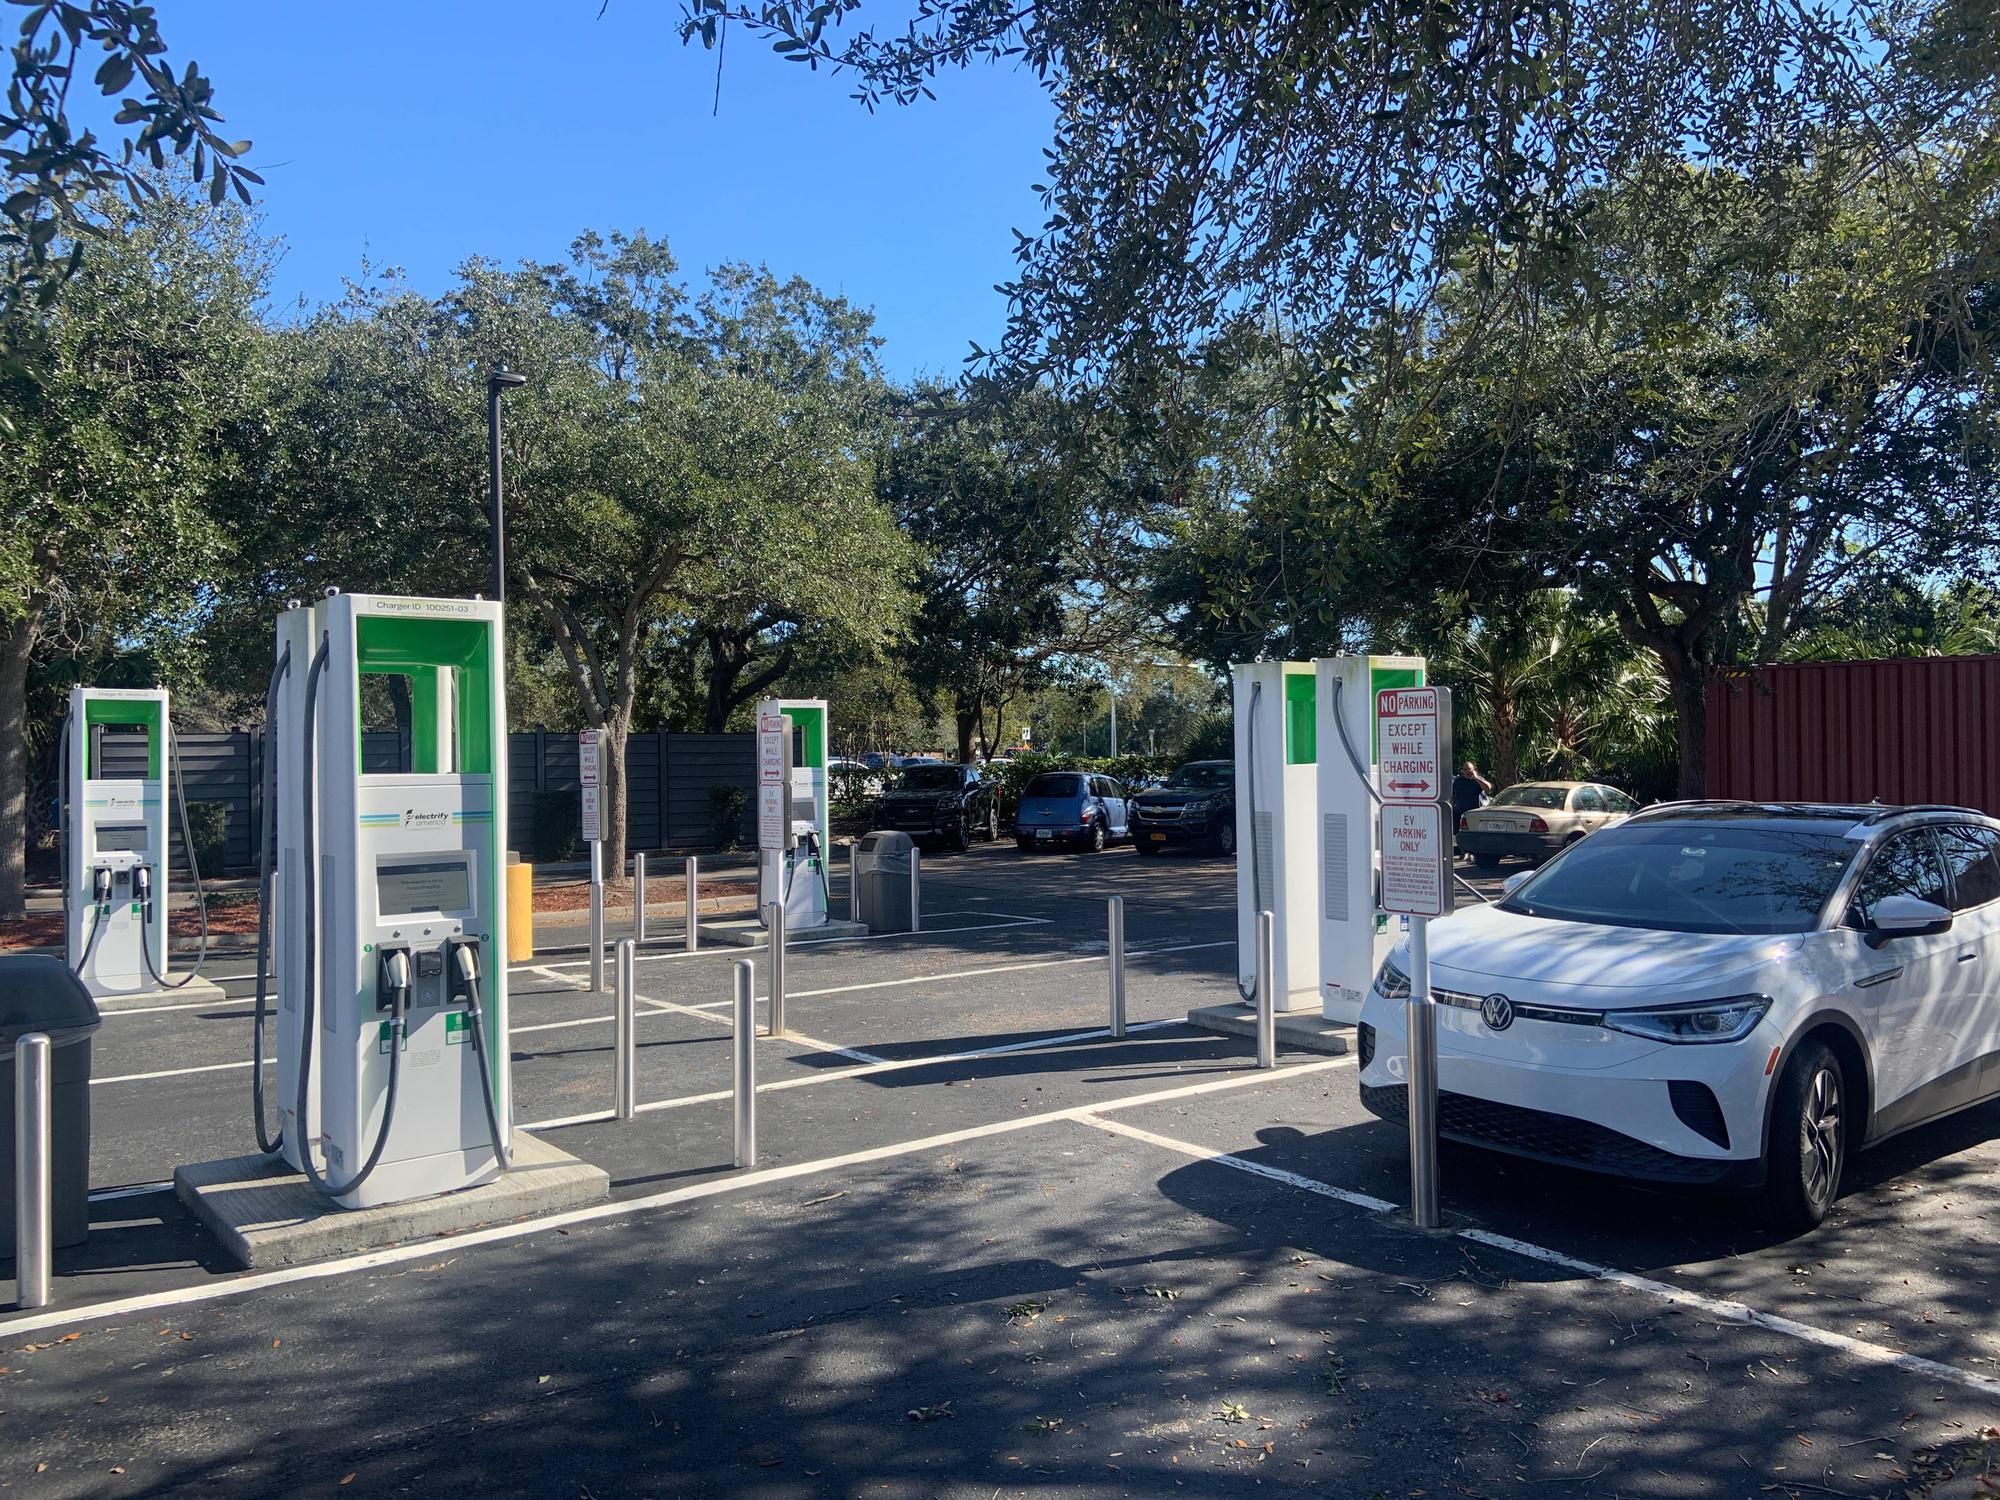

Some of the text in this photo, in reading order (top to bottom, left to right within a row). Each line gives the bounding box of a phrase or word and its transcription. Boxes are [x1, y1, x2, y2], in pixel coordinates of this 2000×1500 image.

[376, 601, 410, 611] Charger
[425, 604, 469, 613] 100251-03
[1381, 695, 1433, 713] NO PARKING
[1388, 723, 1427, 737] EXCEPT
[1392, 742, 1423, 755] WHILE
[1383, 760, 1433, 774] CHARGING
[414, 811, 449, 821] electrify
[1404, 815, 1415, 826] EV
[1393, 827, 1427, 840] PARKING
[1400, 841, 1420, 852] ONLY
